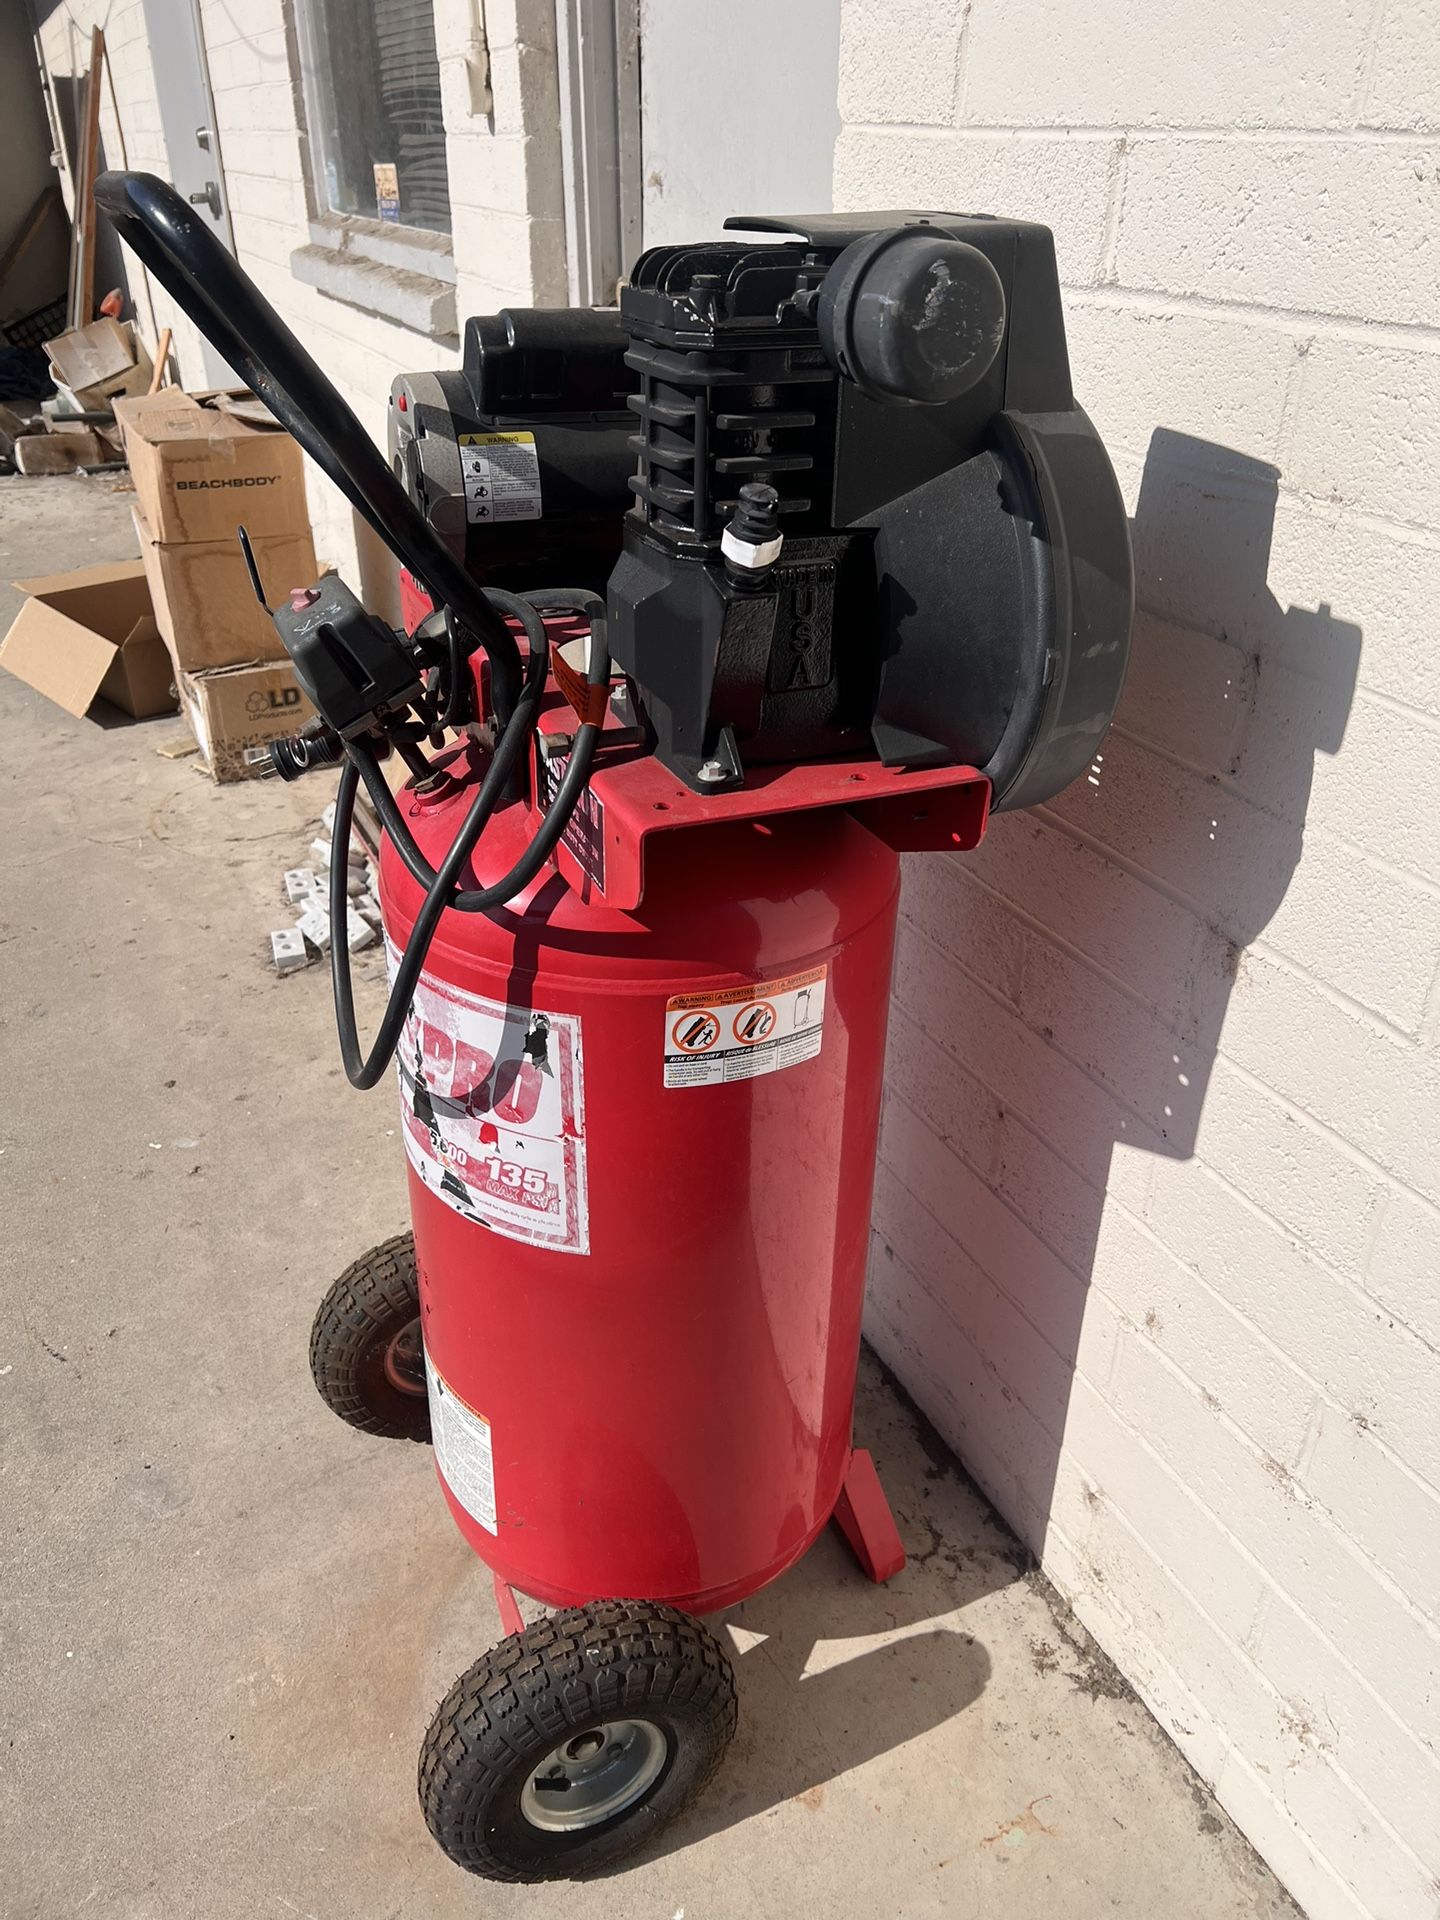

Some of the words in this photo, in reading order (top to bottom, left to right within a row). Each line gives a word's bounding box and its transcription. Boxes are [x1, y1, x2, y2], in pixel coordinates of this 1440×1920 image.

[176, 475, 278, 491] BEACHBODY
[268, 687, 300, 708] LD
[679, 995, 711, 1004] WARNING
[724, 984, 774, 999] AVERTISSEMENT
[696, 1052, 721, 1061] INJURY
[422, 1019, 544, 1125] PRO
[485, 1155, 548, 1195] 135
[485, 1178, 520, 1201] MAX
